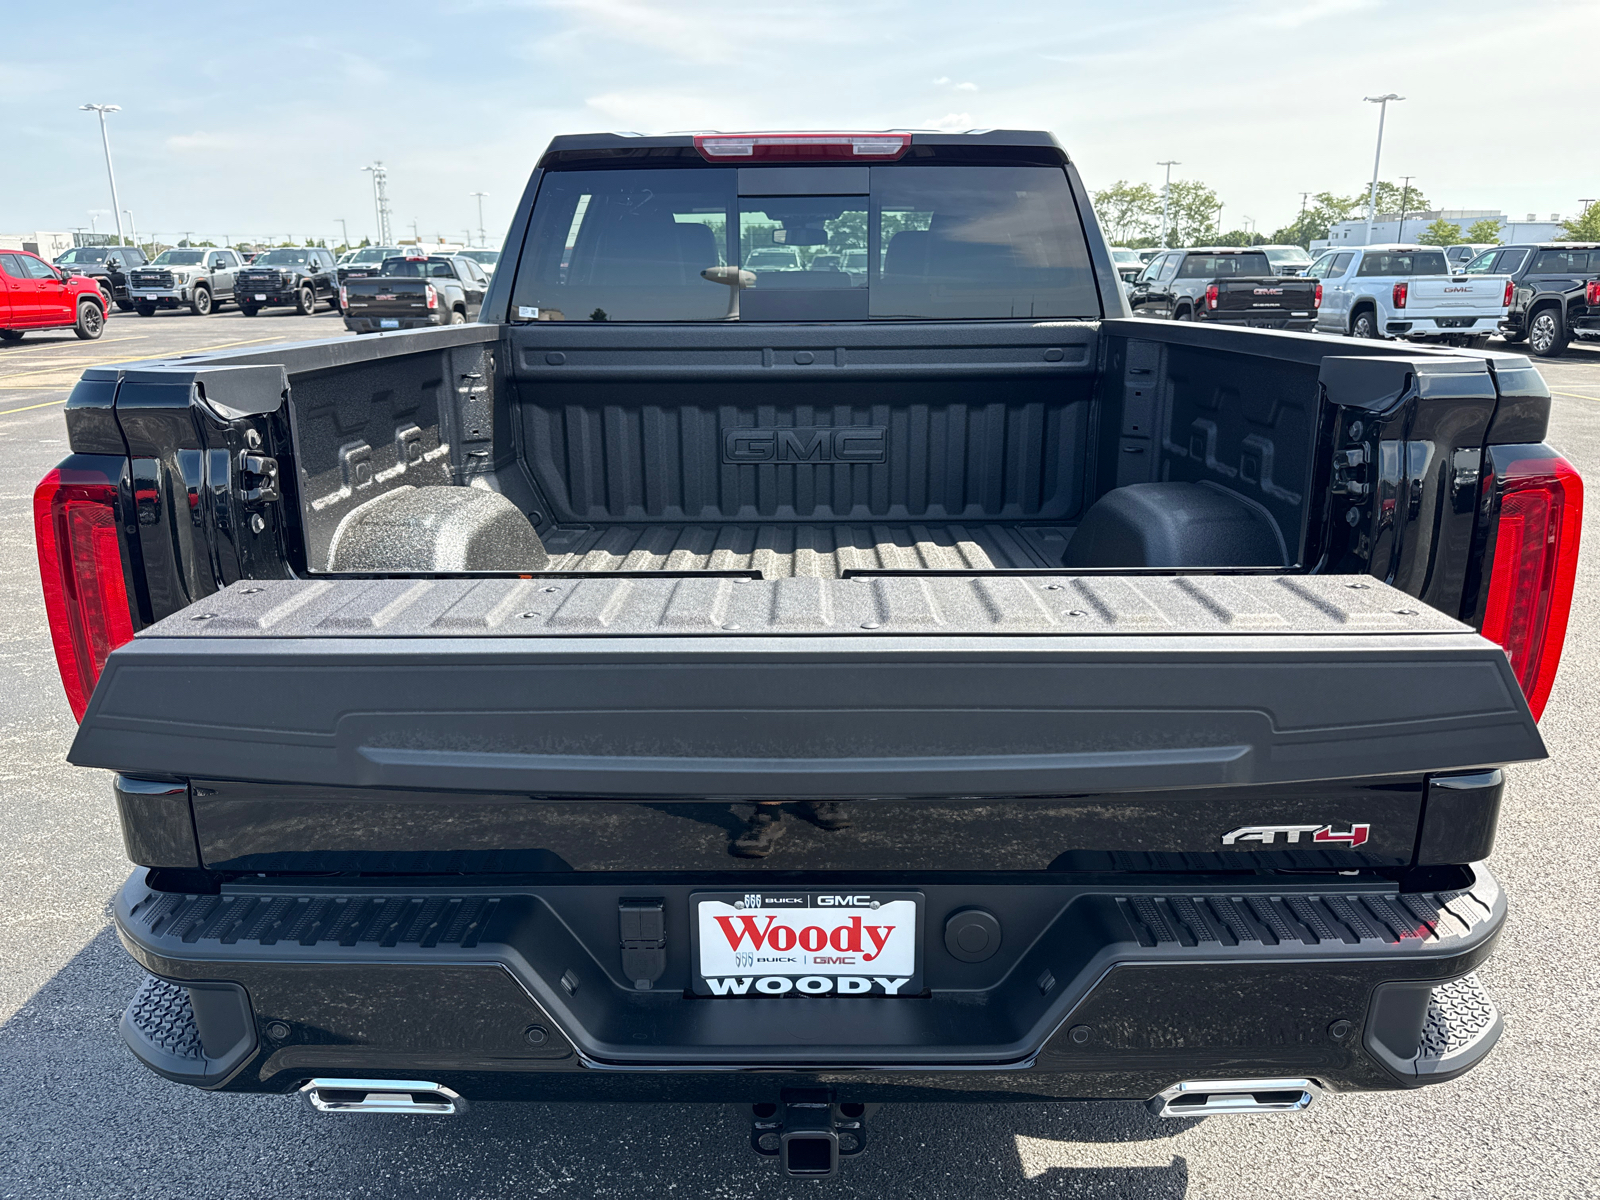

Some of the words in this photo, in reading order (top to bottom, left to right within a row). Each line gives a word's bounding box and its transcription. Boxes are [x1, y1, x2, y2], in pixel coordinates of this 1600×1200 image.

[725, 430, 884, 461] GMC
[1221, 823, 1371, 848] AT4
[817, 895, 871, 906] GMC
[713, 915, 896, 962] Woody
[813, 956, 856, 965] GMC
[706, 976, 910, 996] WOODY
